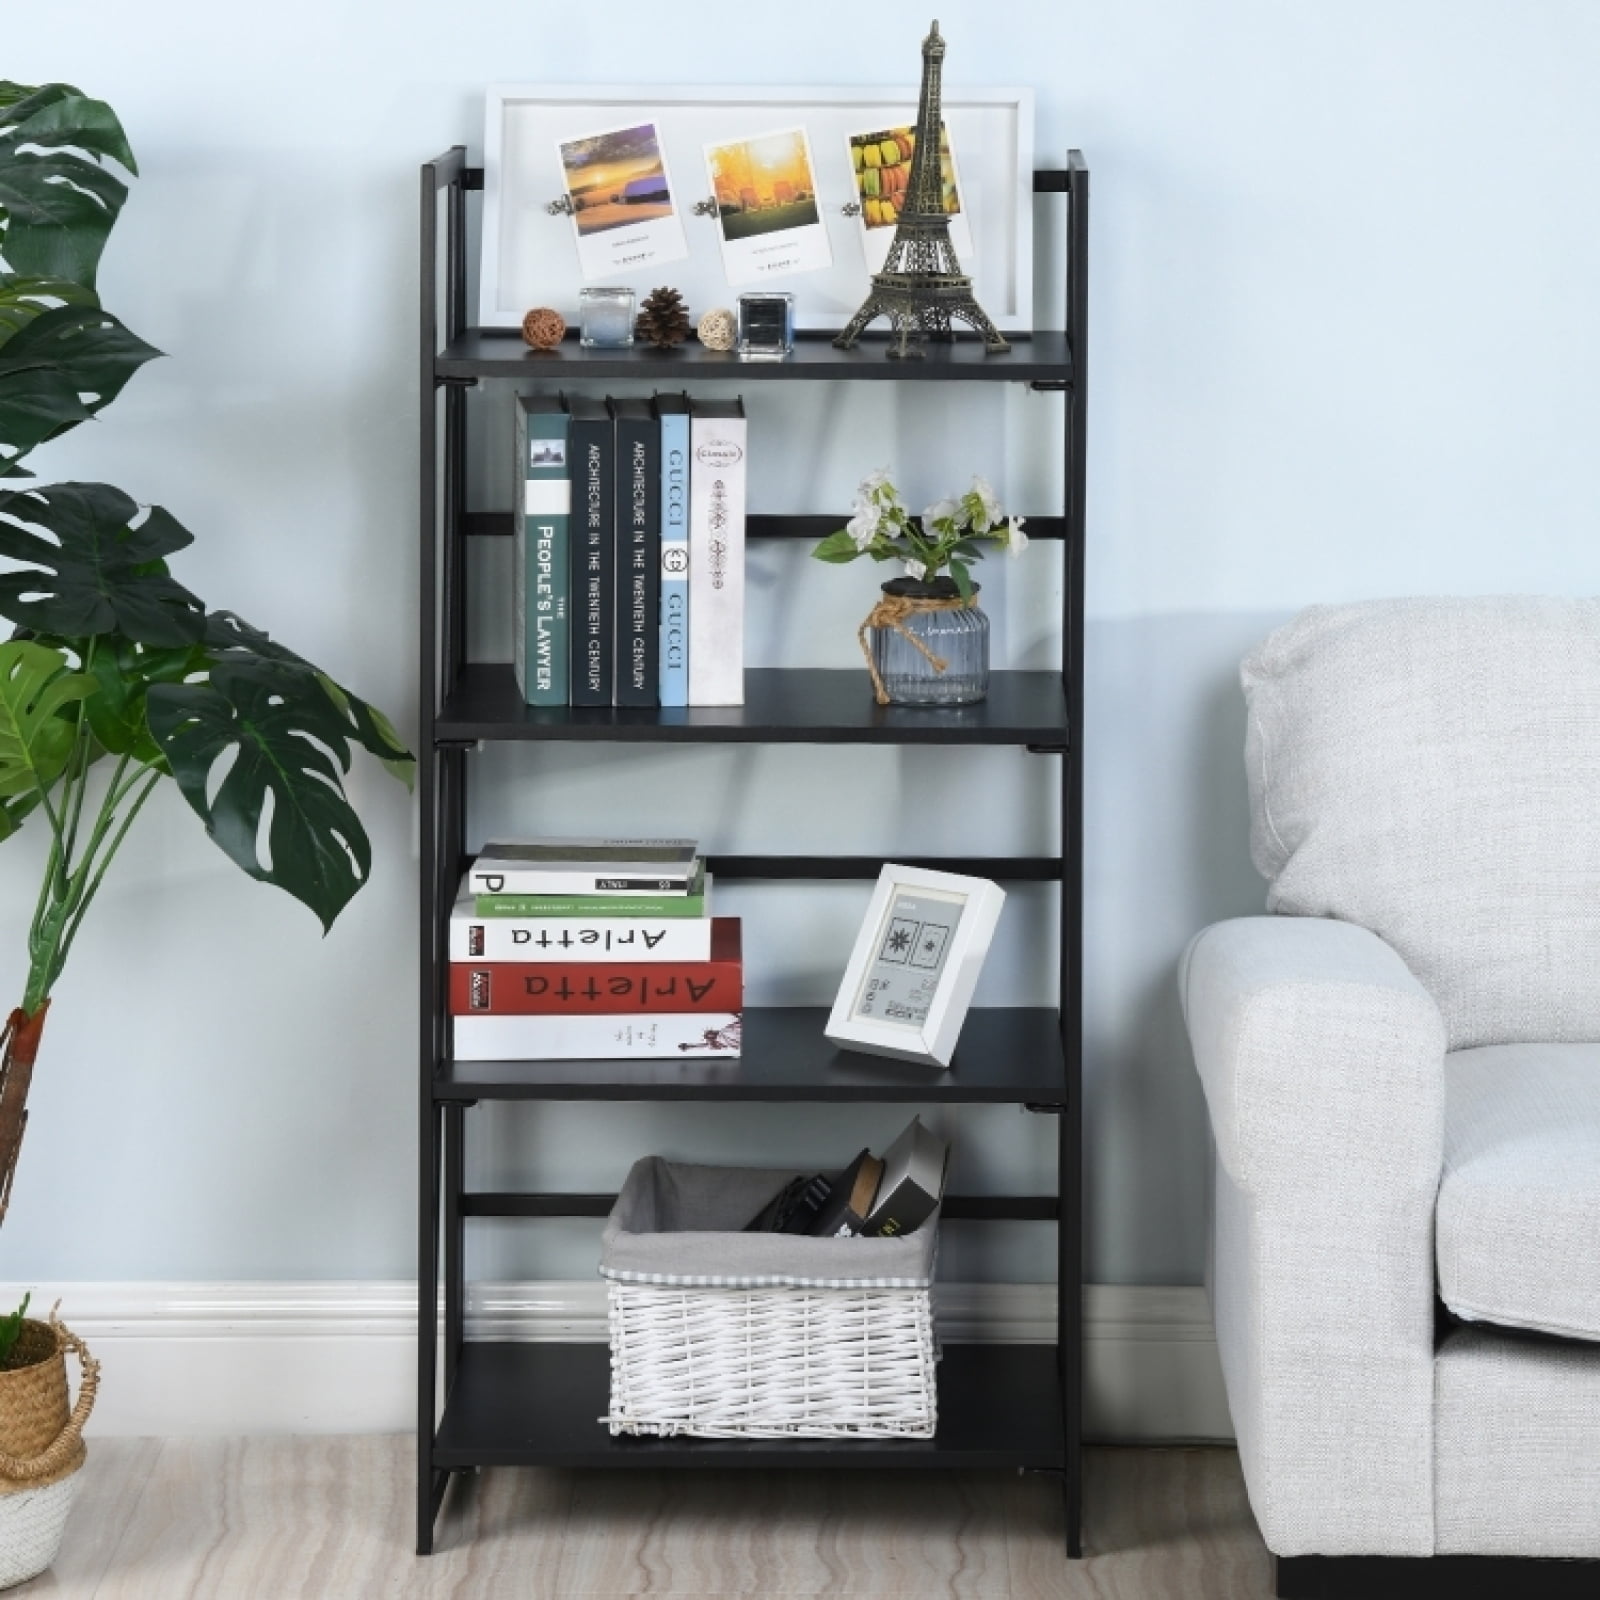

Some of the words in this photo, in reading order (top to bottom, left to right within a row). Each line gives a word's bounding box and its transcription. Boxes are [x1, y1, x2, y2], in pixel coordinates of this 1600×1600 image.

[588, 443, 601, 528] ARCHITECTURE
[632, 441, 645, 526] ARCHITECTURE
[669, 449, 683, 526] GUCCI
[588, 532, 600, 545] IN
[588, 551, 600, 571] THE
[632, 530, 645, 543] IN
[632, 549, 645, 569] THE
[536, 525, 554, 612] PEOPLE'S
[588, 576, 600, 635] TWENTIETH
[632, 574, 645, 633] TWENTIETH
[668, 592, 682, 670] GUCCI
[536, 615, 554, 690] LAWYER
[588, 641, 600, 692] CENTURY
[632, 637, 645, 690] CENTURY
[511, 929, 667, 952] Arletta
[524, 975, 716, 1005] Arletta
